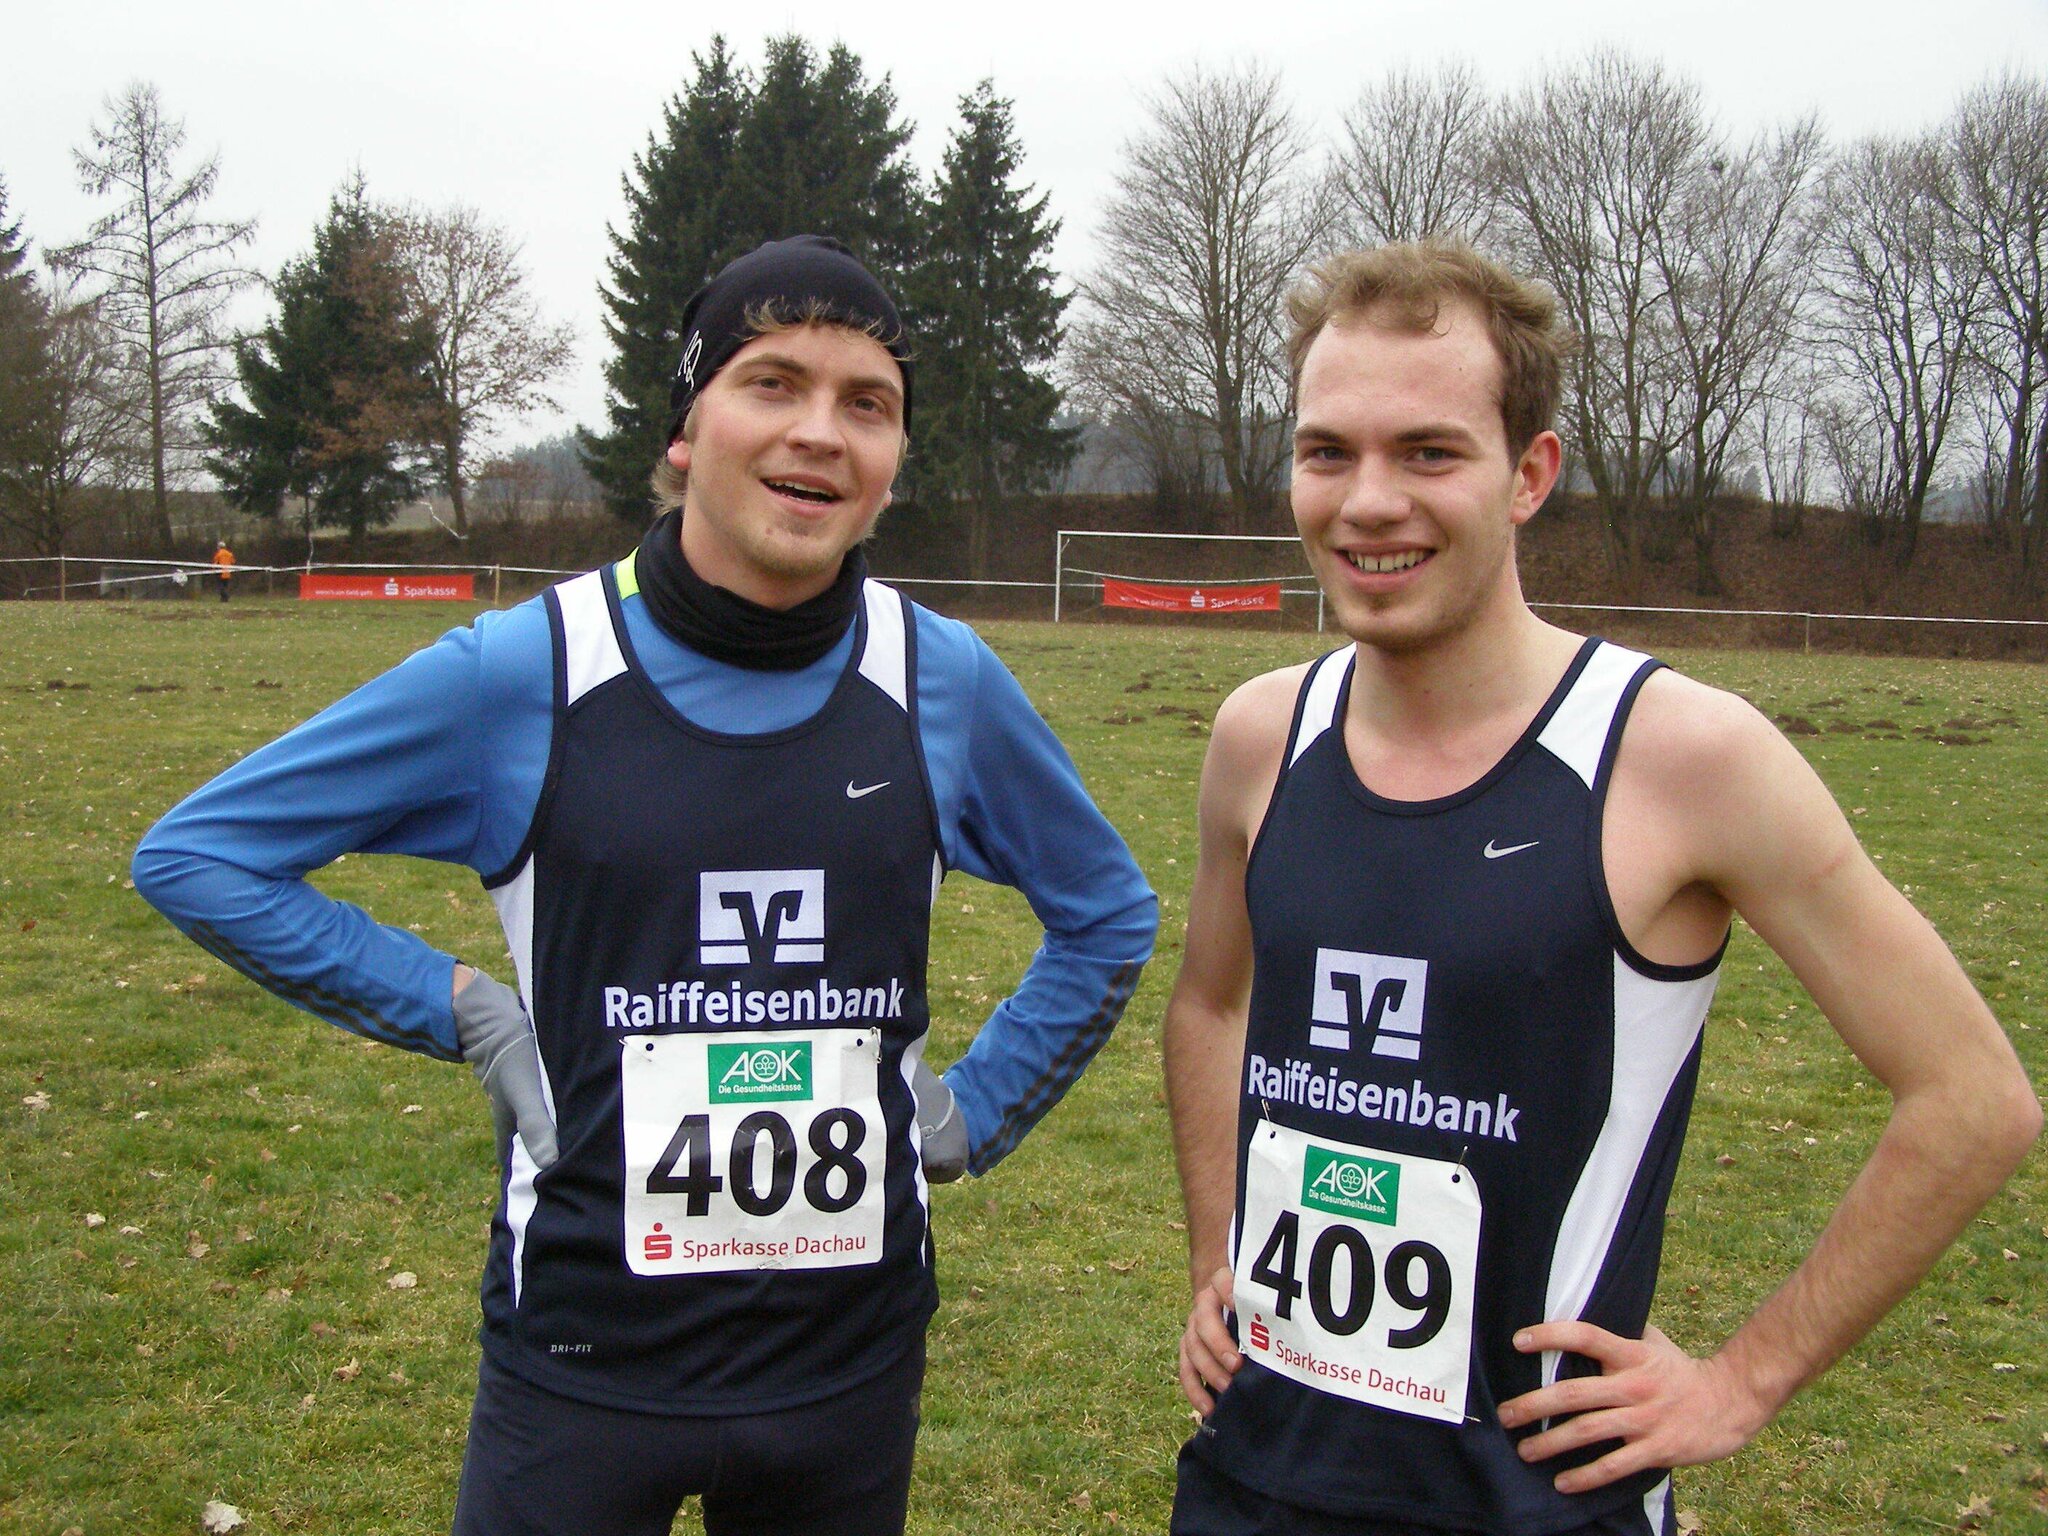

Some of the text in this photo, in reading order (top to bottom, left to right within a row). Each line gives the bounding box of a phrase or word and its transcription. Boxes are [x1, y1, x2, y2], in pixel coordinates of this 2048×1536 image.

[404, 586, 457, 597] Sparkasse
[603, 978, 905, 1027] Raiffeisenbank
[720, 1049, 803, 1084] AOK
[718, 1085, 731, 1094] Die
[1248, 1054, 1521, 1142] Raiffeisenbank
[646, 1107, 867, 1217] 408
[1311, 1159, 1389, 1204] AOK
[1308, 1188, 1320, 1200] Die
[683, 1237, 789, 1262] Sparkasse
[795, 1234, 866, 1255] Dachau
[1250, 1209, 1452, 1349] 409
[550, 1344, 593, 1353] DRI-FIT
[1275, 1339, 1362, 1384] Sparkasse
[1368, 1369, 1446, 1404] Dachau
